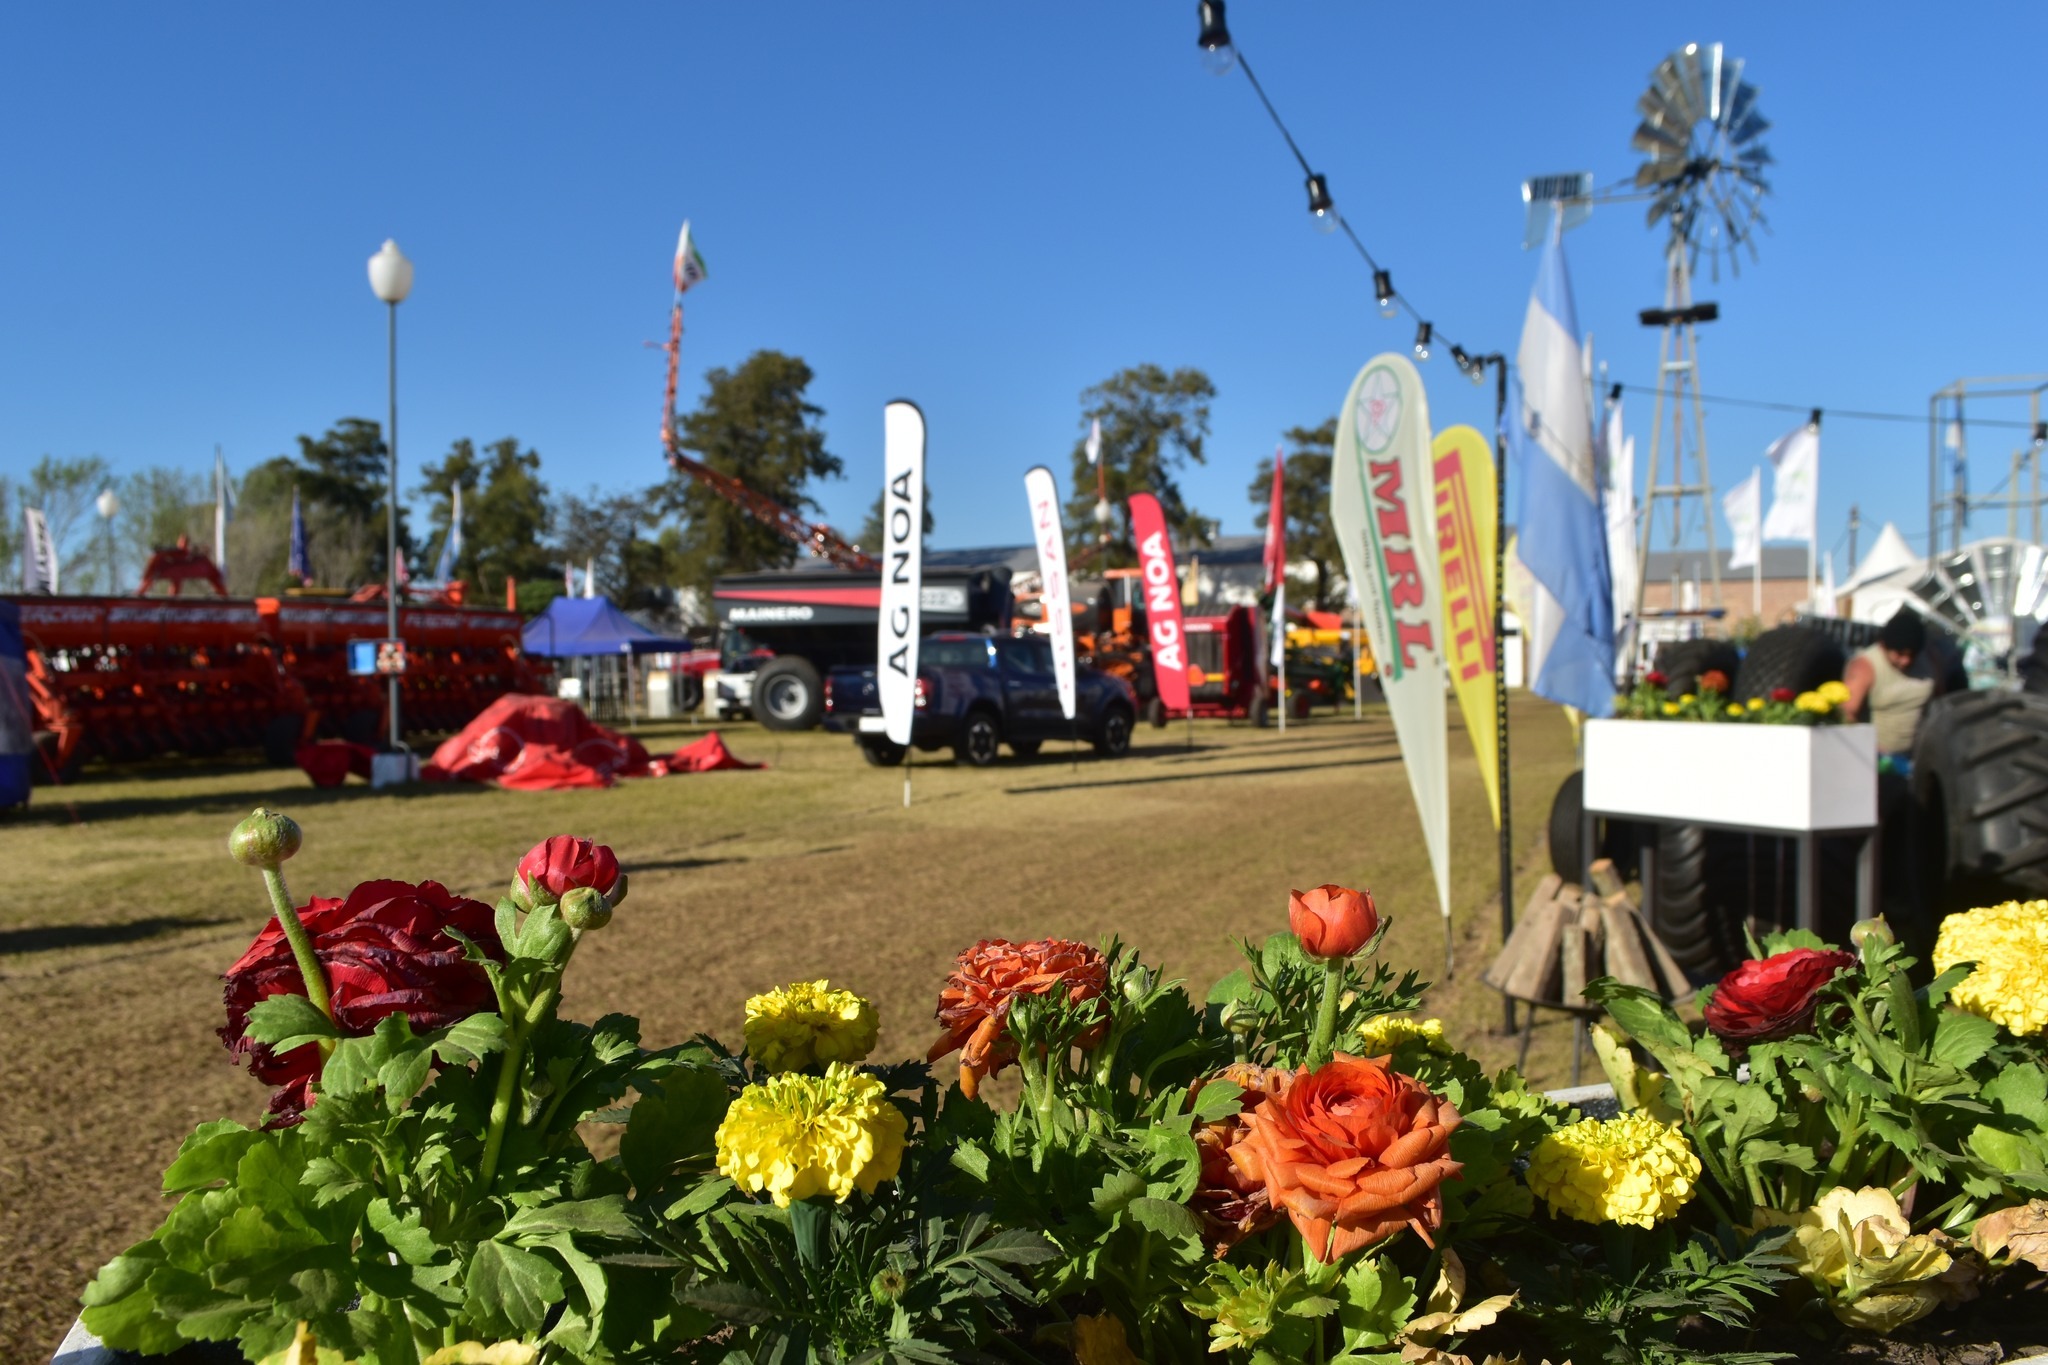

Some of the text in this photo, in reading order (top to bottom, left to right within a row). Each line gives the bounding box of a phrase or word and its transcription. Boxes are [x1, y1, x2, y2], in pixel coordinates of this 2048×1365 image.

[728, 606, 814, 623] MAINERO
[887, 467, 913, 678] AG NOA
[1141, 530, 1183, 672] AG NOA
[1368, 457, 1435, 670] MRL
[1434, 446, 1497, 682] PIRELLI
